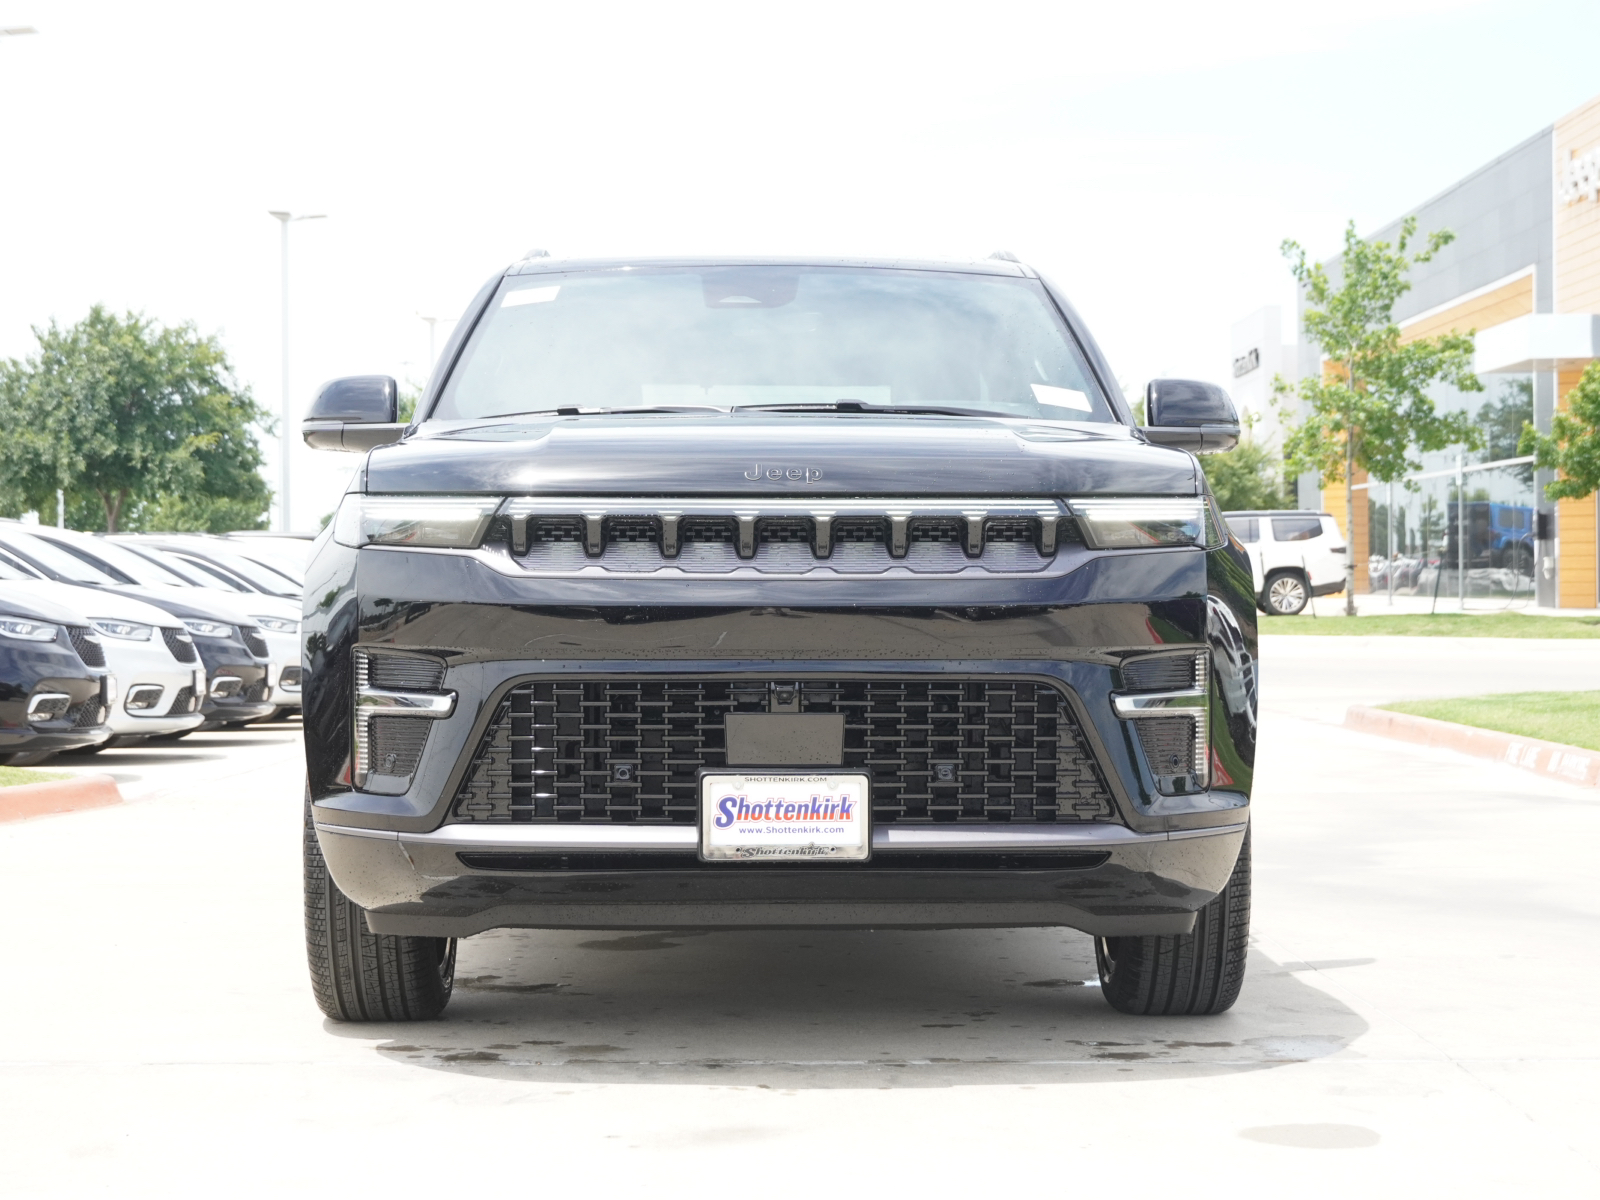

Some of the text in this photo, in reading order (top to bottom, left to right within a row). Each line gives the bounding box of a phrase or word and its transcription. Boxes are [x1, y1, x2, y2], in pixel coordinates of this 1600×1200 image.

[744, 463, 823, 484] Jeep
[714, 795, 854, 829] Shottenkirk
[738, 826, 845, 834] www.Shottenkirk.com
